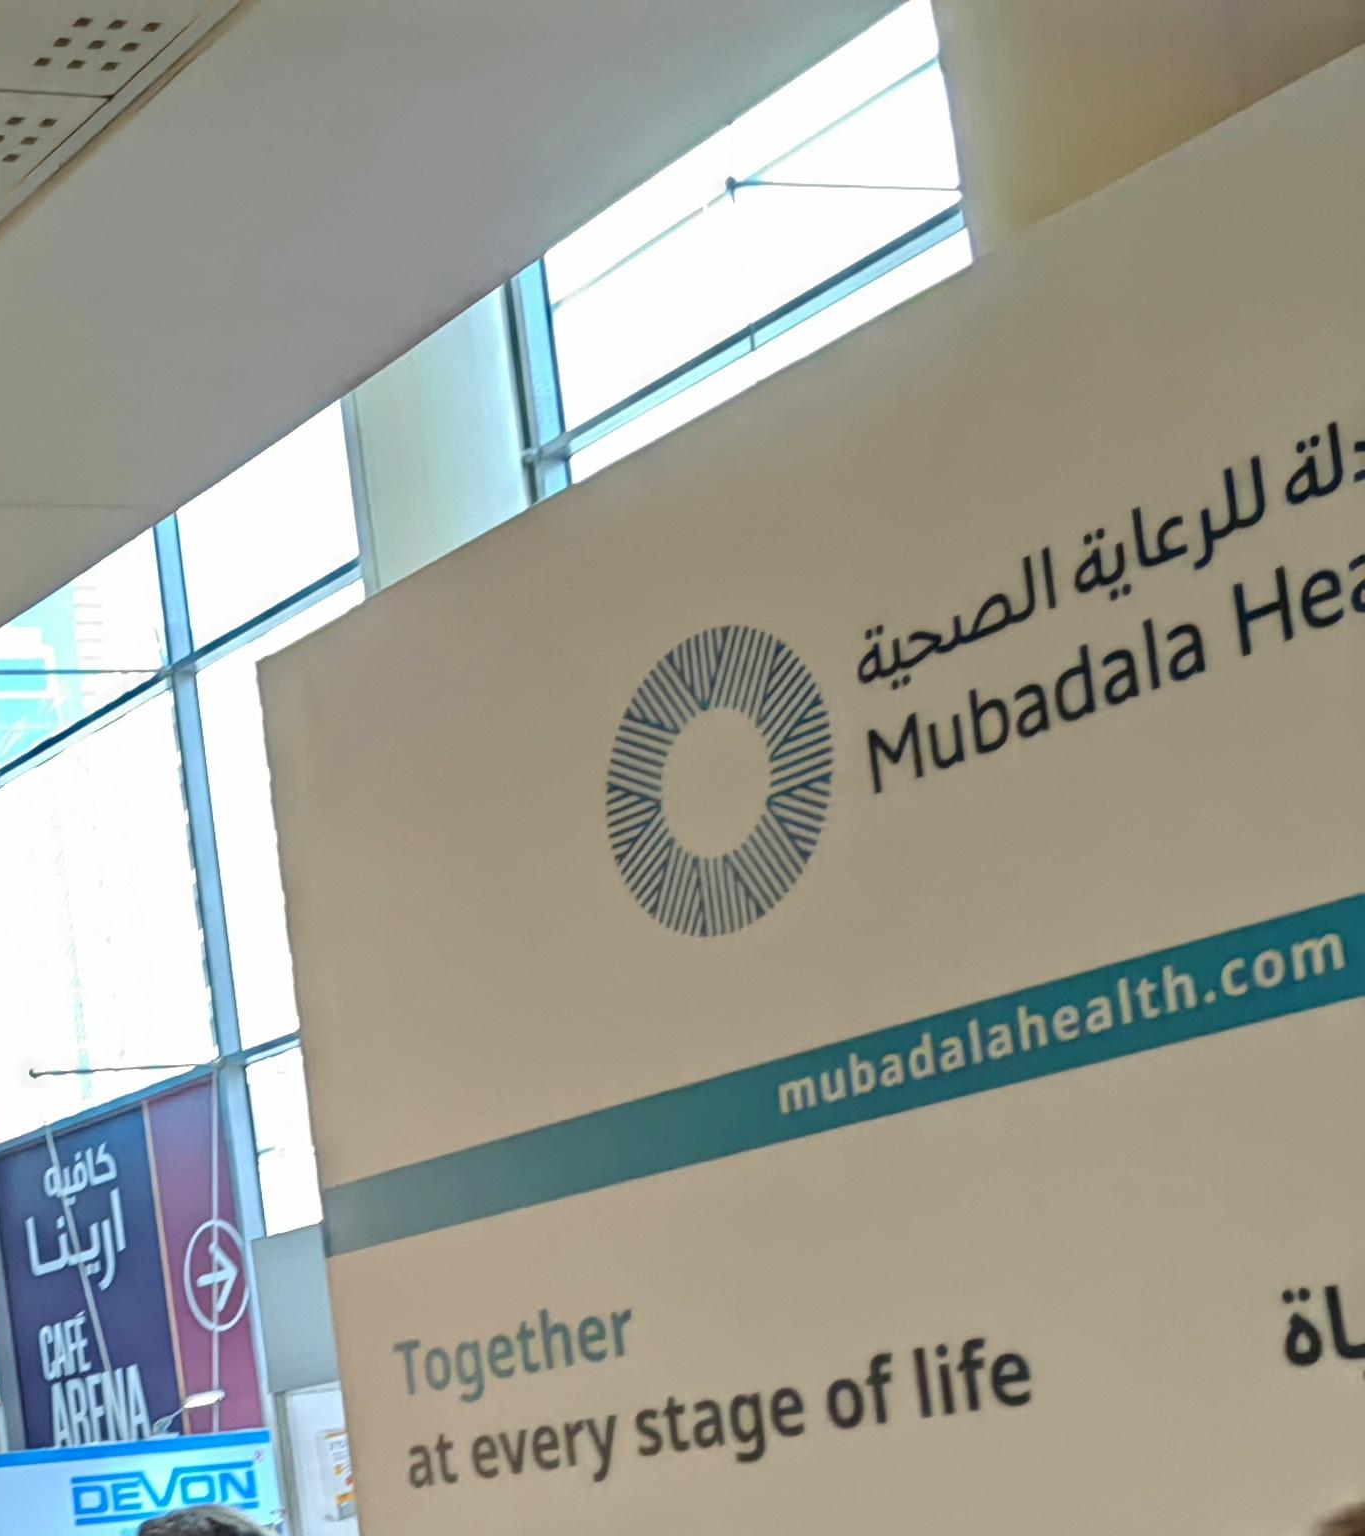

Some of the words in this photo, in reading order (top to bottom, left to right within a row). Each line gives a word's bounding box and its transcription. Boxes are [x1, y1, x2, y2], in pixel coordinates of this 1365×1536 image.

[1073, 455, 1266, 600] للرعاية
[856, 547, 1057, 690] الصحية
[867, 619, 1207, 794] Mubadala
[777, 931, 1347, 1113] mubadalahealth.com
[43, 1142, 117, 1207] كافيه
[51, 1364, 151, 1447] ARENA
[394, 1306, 633, 1402] Together
[407, 1434, 459, 1488] at
[471, 1413, 618, 1482] every
[636, 1385, 806, 1463] stage
[826, 1352, 893, 1430] of
[913, 1339, 1034, 1419] life
[71, 1460, 259, 1526] DEVON
